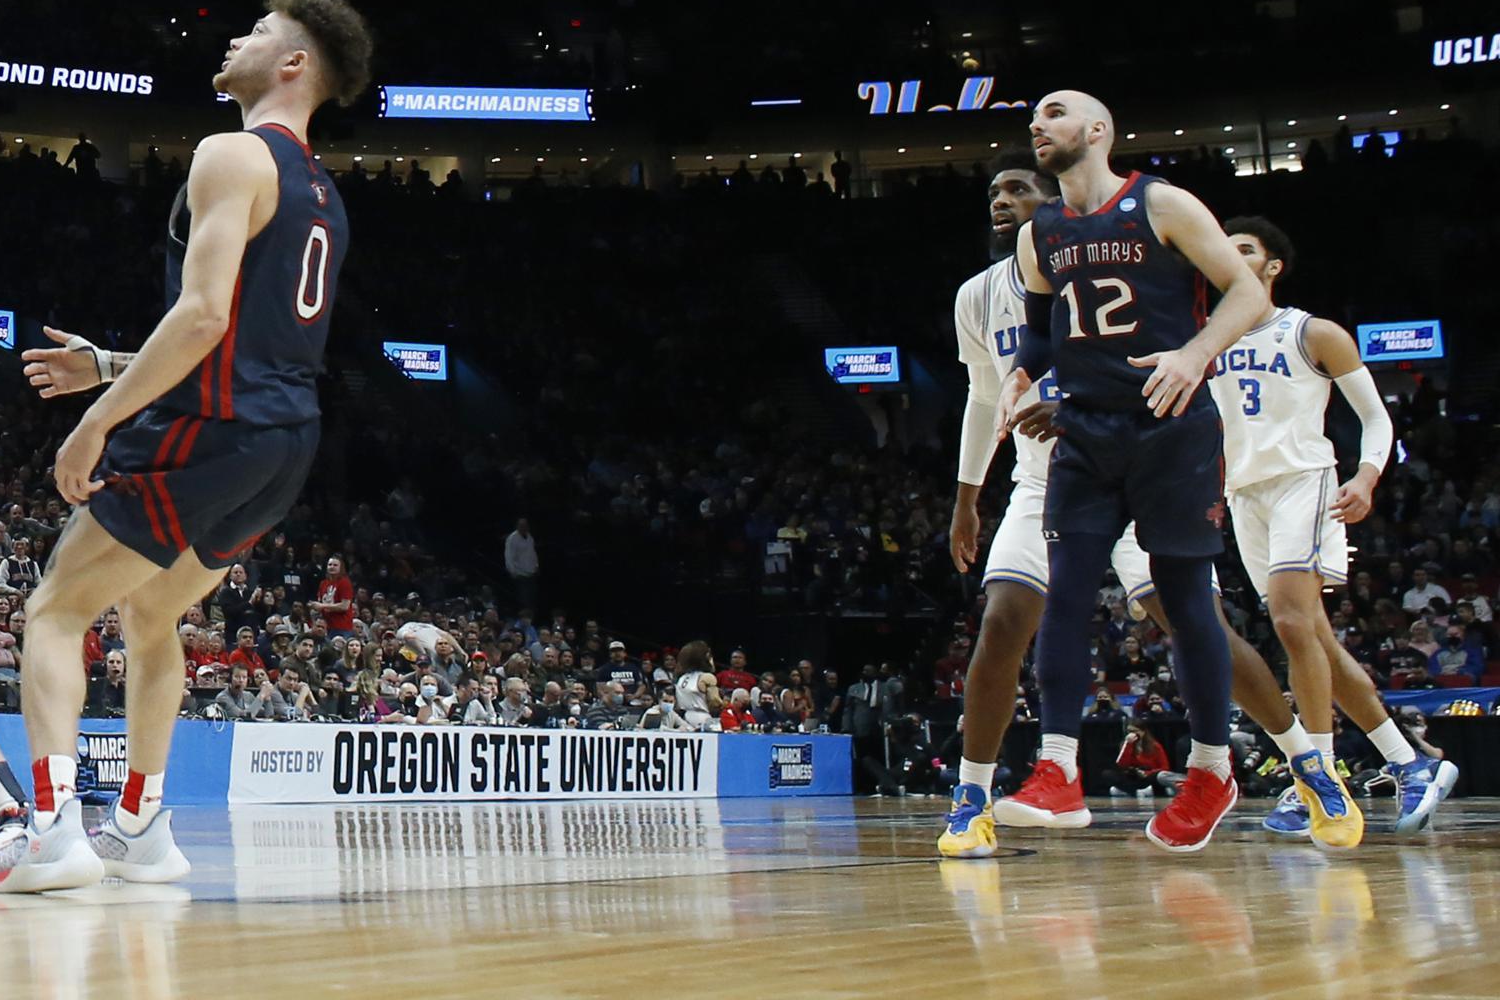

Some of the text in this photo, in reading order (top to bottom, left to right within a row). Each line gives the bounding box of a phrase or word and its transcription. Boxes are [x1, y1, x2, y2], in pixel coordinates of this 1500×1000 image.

[51, 67, 154, 96] ROUNDS
[392, 94, 581, 113] #MARCHMADNESS
[1049, 241, 1143, 273] SAINT MARY'S
[296, 224, 329, 320] 0
[1059, 277, 1139, 339] 12
[1380, 330, 1416, 341] MARCH
[1385, 338, 1434, 351] MADNESS
[400, 350, 428, 361] MARCH
[845, 354, 876, 364] MARCH
[1213, 348, 1292, 378] UCLA
[403, 360, 440, 371] MADNESS
[849, 363, 891, 374] MADNESS
[1238, 378, 1261, 416] 3
[89, 736, 128, 760] MARC
[777, 747, 802, 764] MARCH
[251, 731, 704, 794] HOSTED BY OREGON STATE UNIVERSITY
[781, 764, 813, 780] MADNESS
